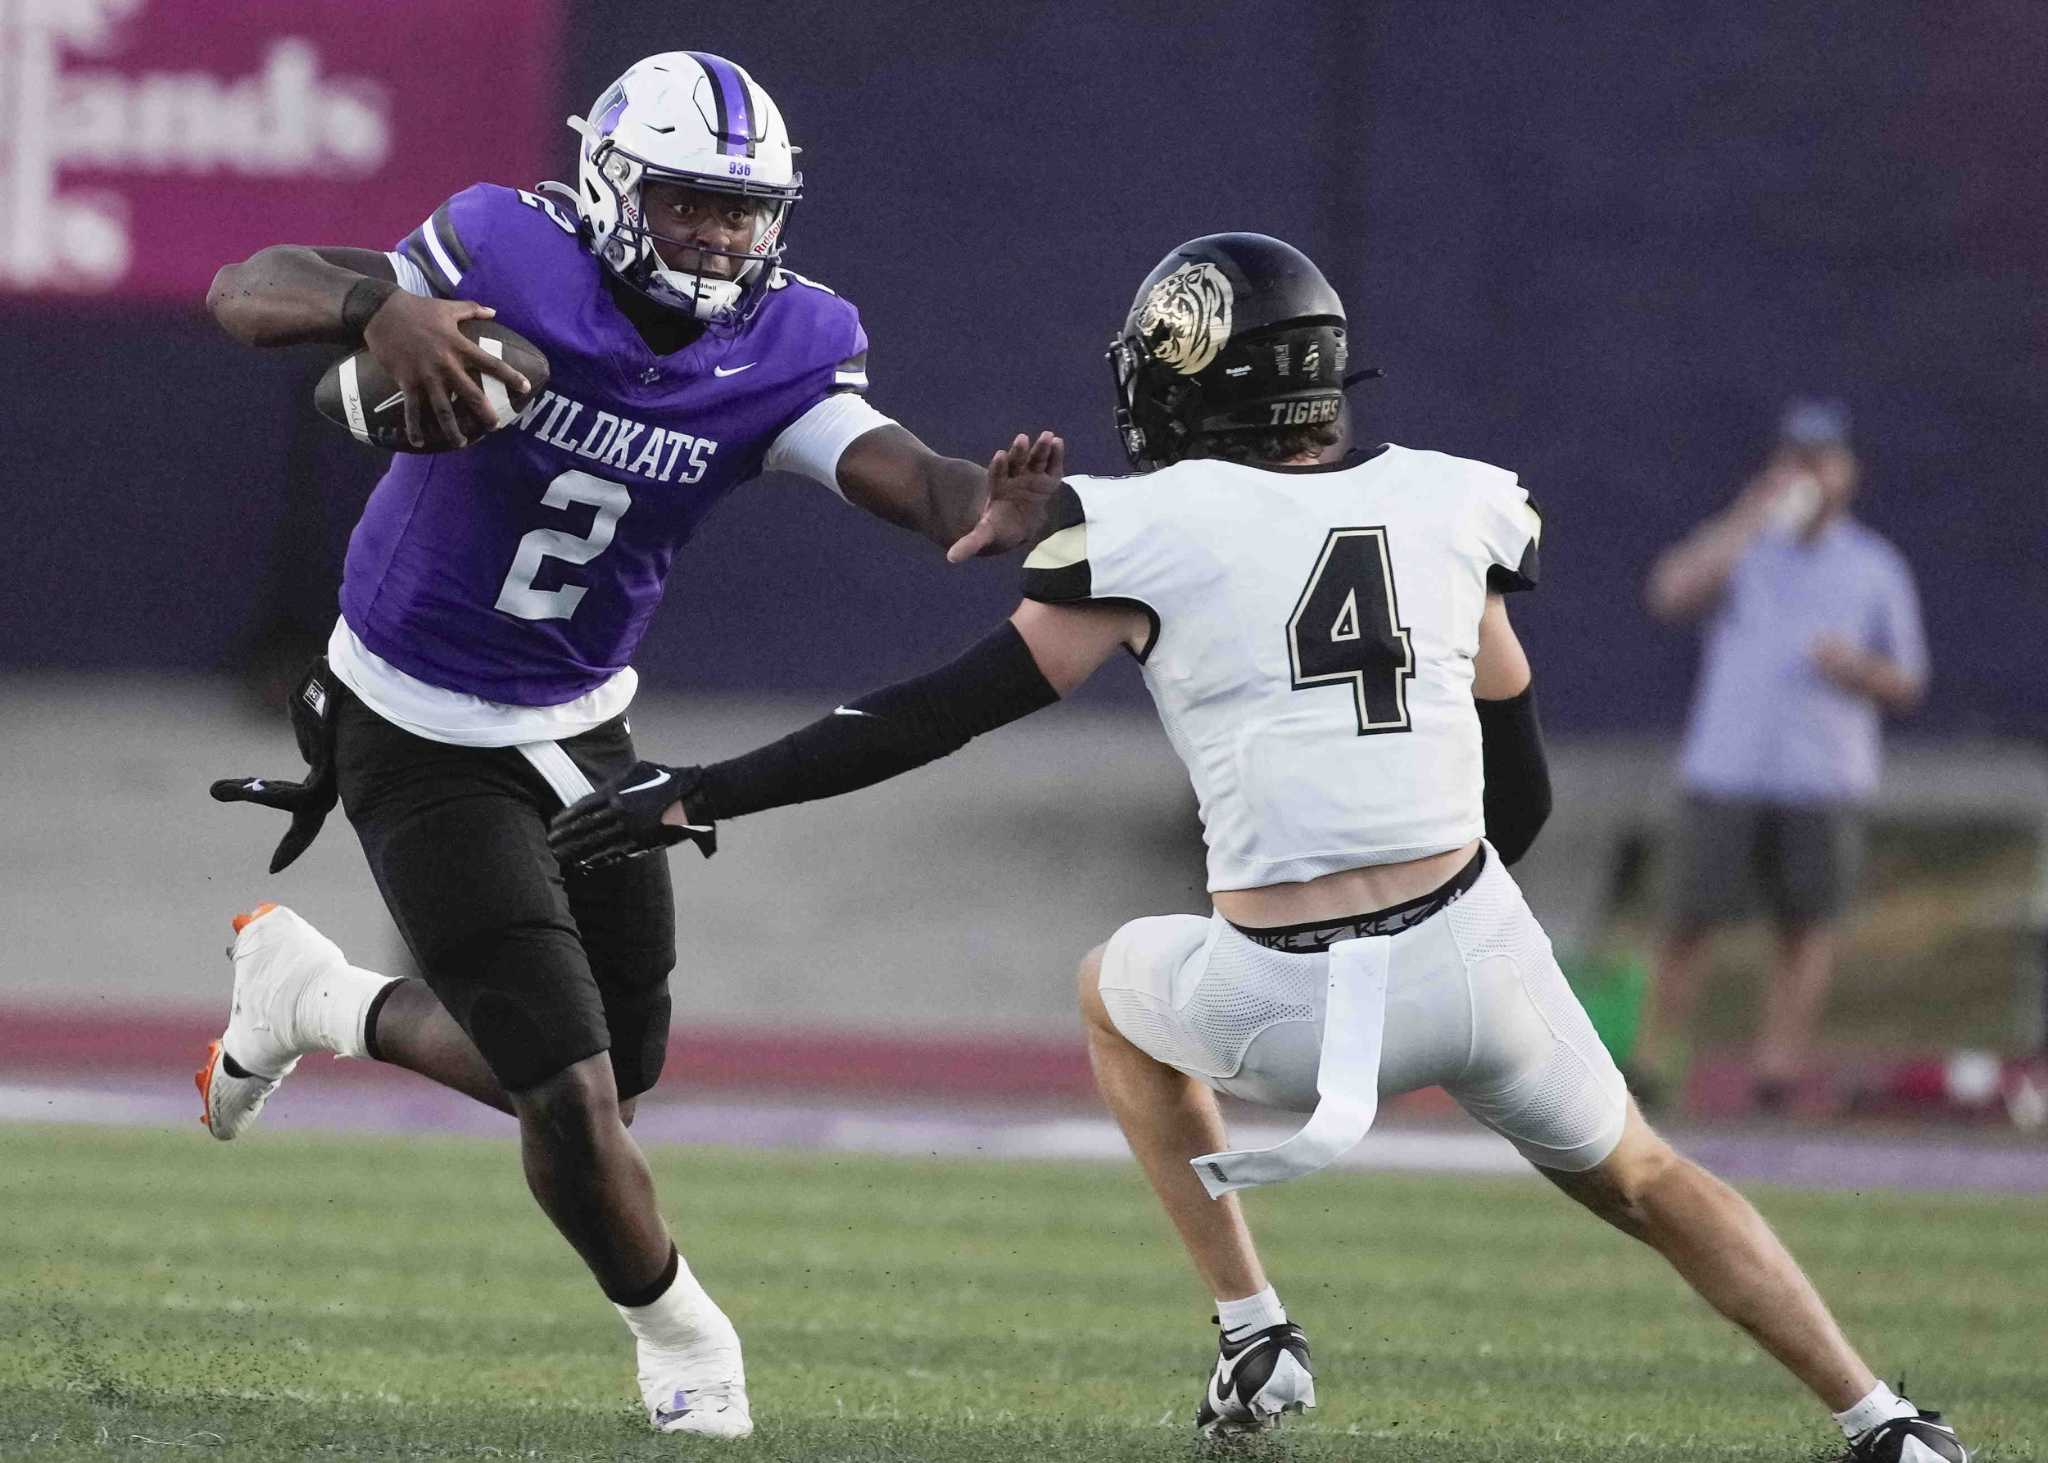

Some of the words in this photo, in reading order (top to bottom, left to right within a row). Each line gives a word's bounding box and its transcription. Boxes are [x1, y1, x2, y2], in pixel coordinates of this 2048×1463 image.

[728, 161, 751, 176] 936
[1270, 399, 1339, 425] TIGERS
[494, 468, 632, 621] 2
[1285, 525, 1416, 737] 4
